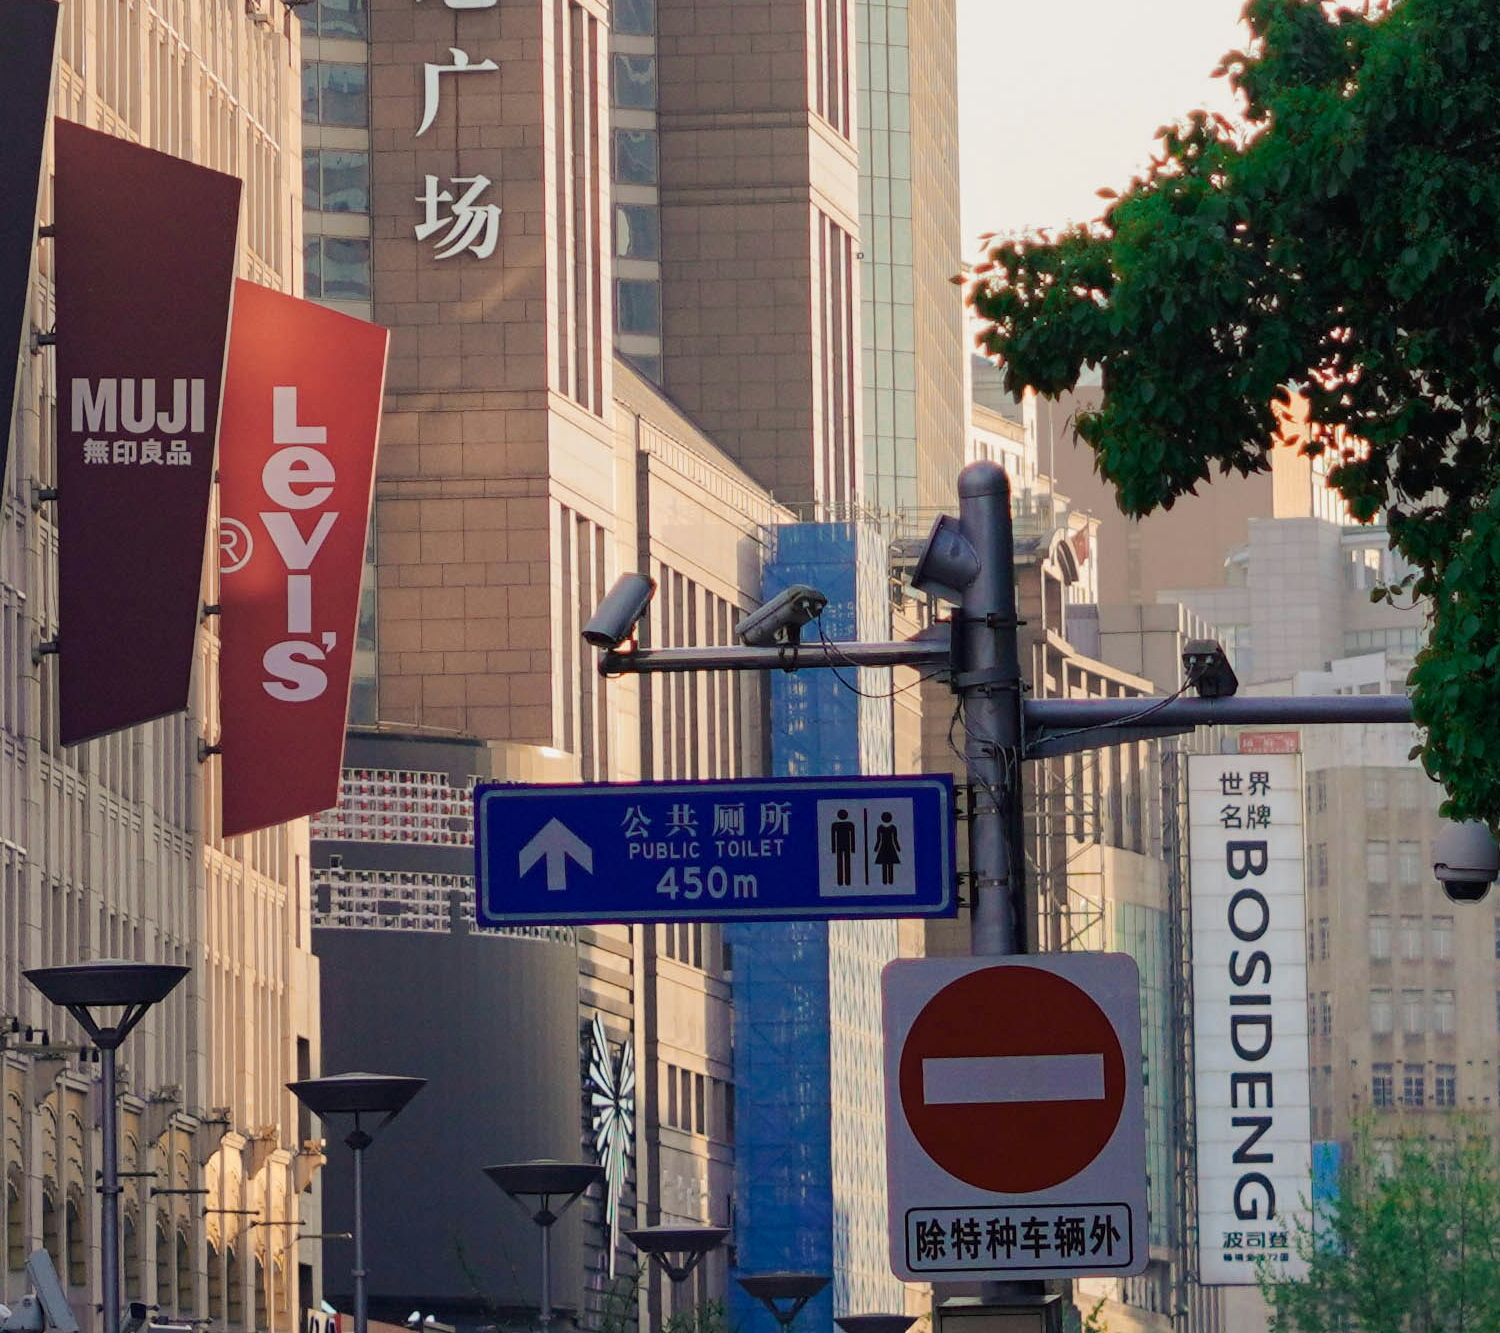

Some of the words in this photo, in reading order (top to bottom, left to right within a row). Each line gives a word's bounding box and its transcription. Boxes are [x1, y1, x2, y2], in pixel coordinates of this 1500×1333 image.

[71, 377, 206, 435] MUJI
[83, 438, 192, 466] 無印良品
[1219, 771, 1271, 796] 世界
[620, 802, 793, 838] 公共厕所
[1220, 804, 1271, 829] 名牌
[629, 842, 700, 860] PUBLIC
[715, 839, 785, 857] TOILET
[656, 865, 759, 900] 450m
[1225, 839, 1278, 1221] BOSIDENG
[915, 1214, 1121, 1261] 除特种车辆外
[1223, 1231, 1289, 1249] 波司登
